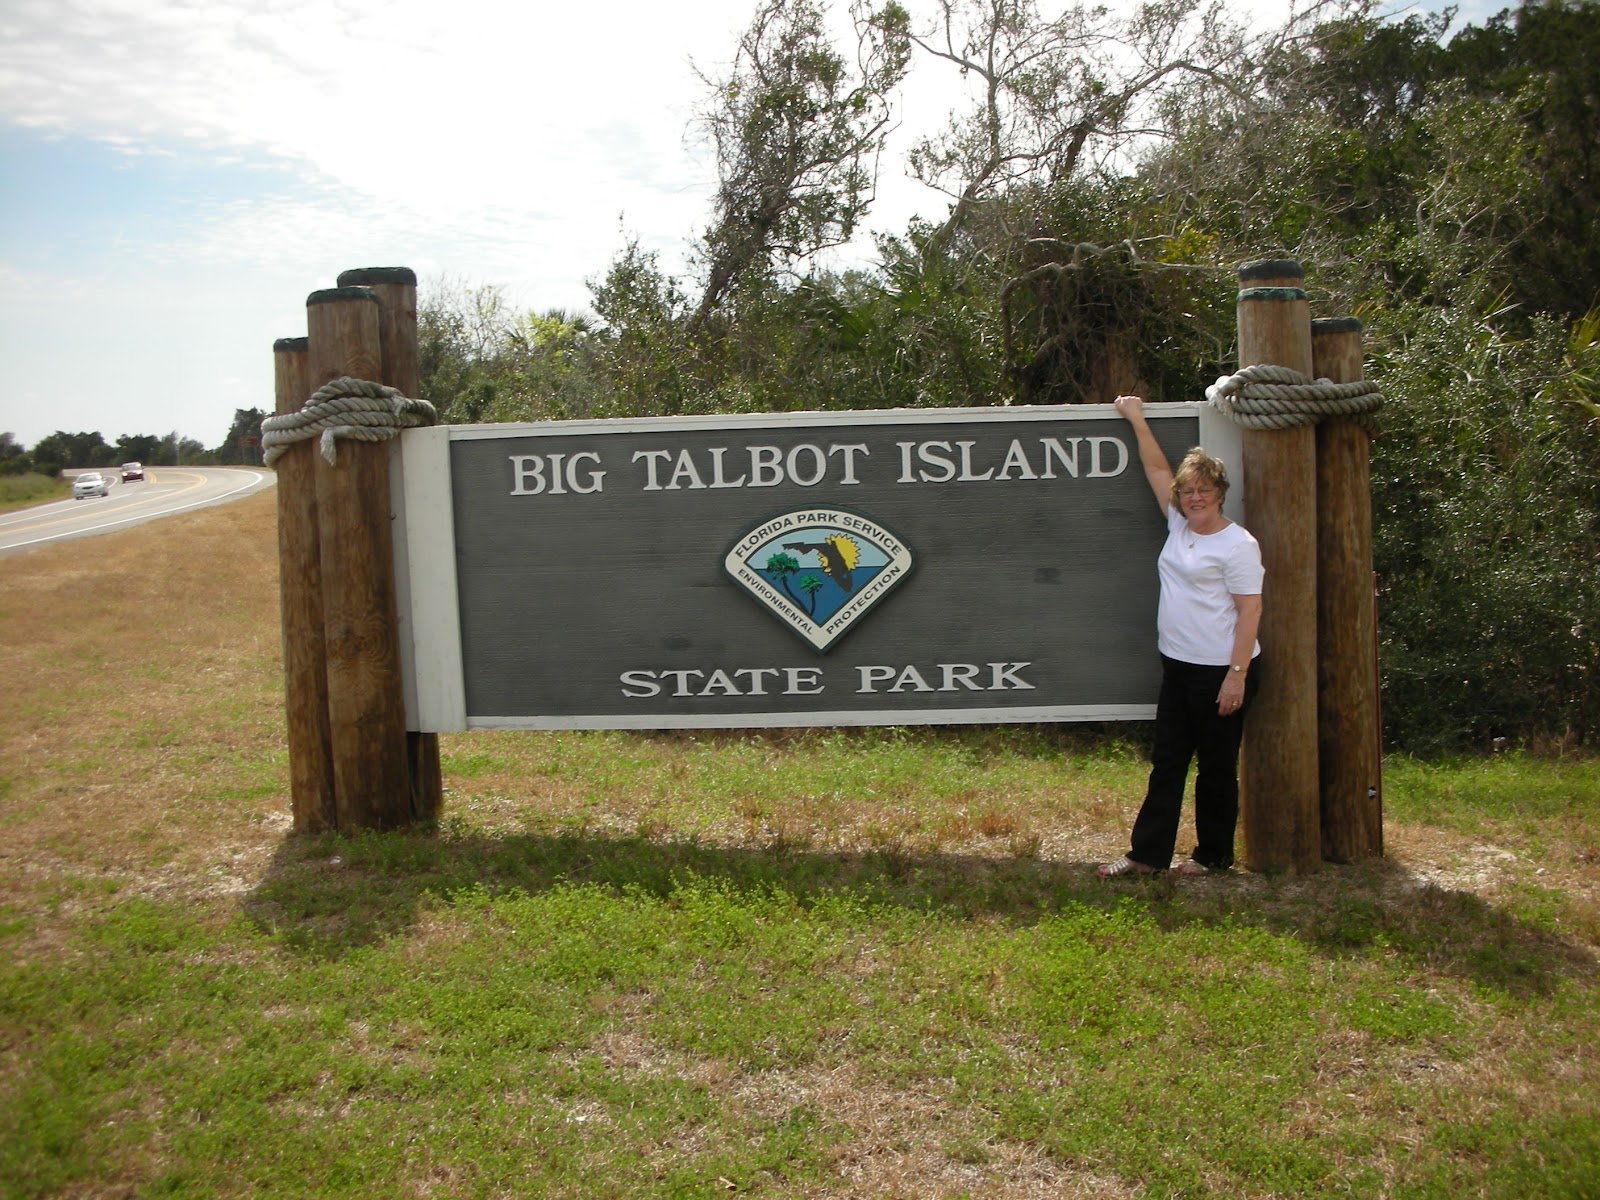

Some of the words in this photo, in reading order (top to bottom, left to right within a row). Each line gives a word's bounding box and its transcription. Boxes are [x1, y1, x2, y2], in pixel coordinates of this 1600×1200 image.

[508, 451, 607, 496] BIG
[632, 443, 870, 492] TALBOT
[896, 436, 1129, 484] ISLAND
[735, 518, 793, 558] FLORIDA
[797, 512, 839, 524] PARK
[842, 516, 902, 555] SERVICE
[737, 568, 813, 635] ENVIRONMENTAL
[826, 566, 901, 634] PROTECTION
[619, 667, 825, 698] STATE
[855, 662, 1036, 694] PARK
